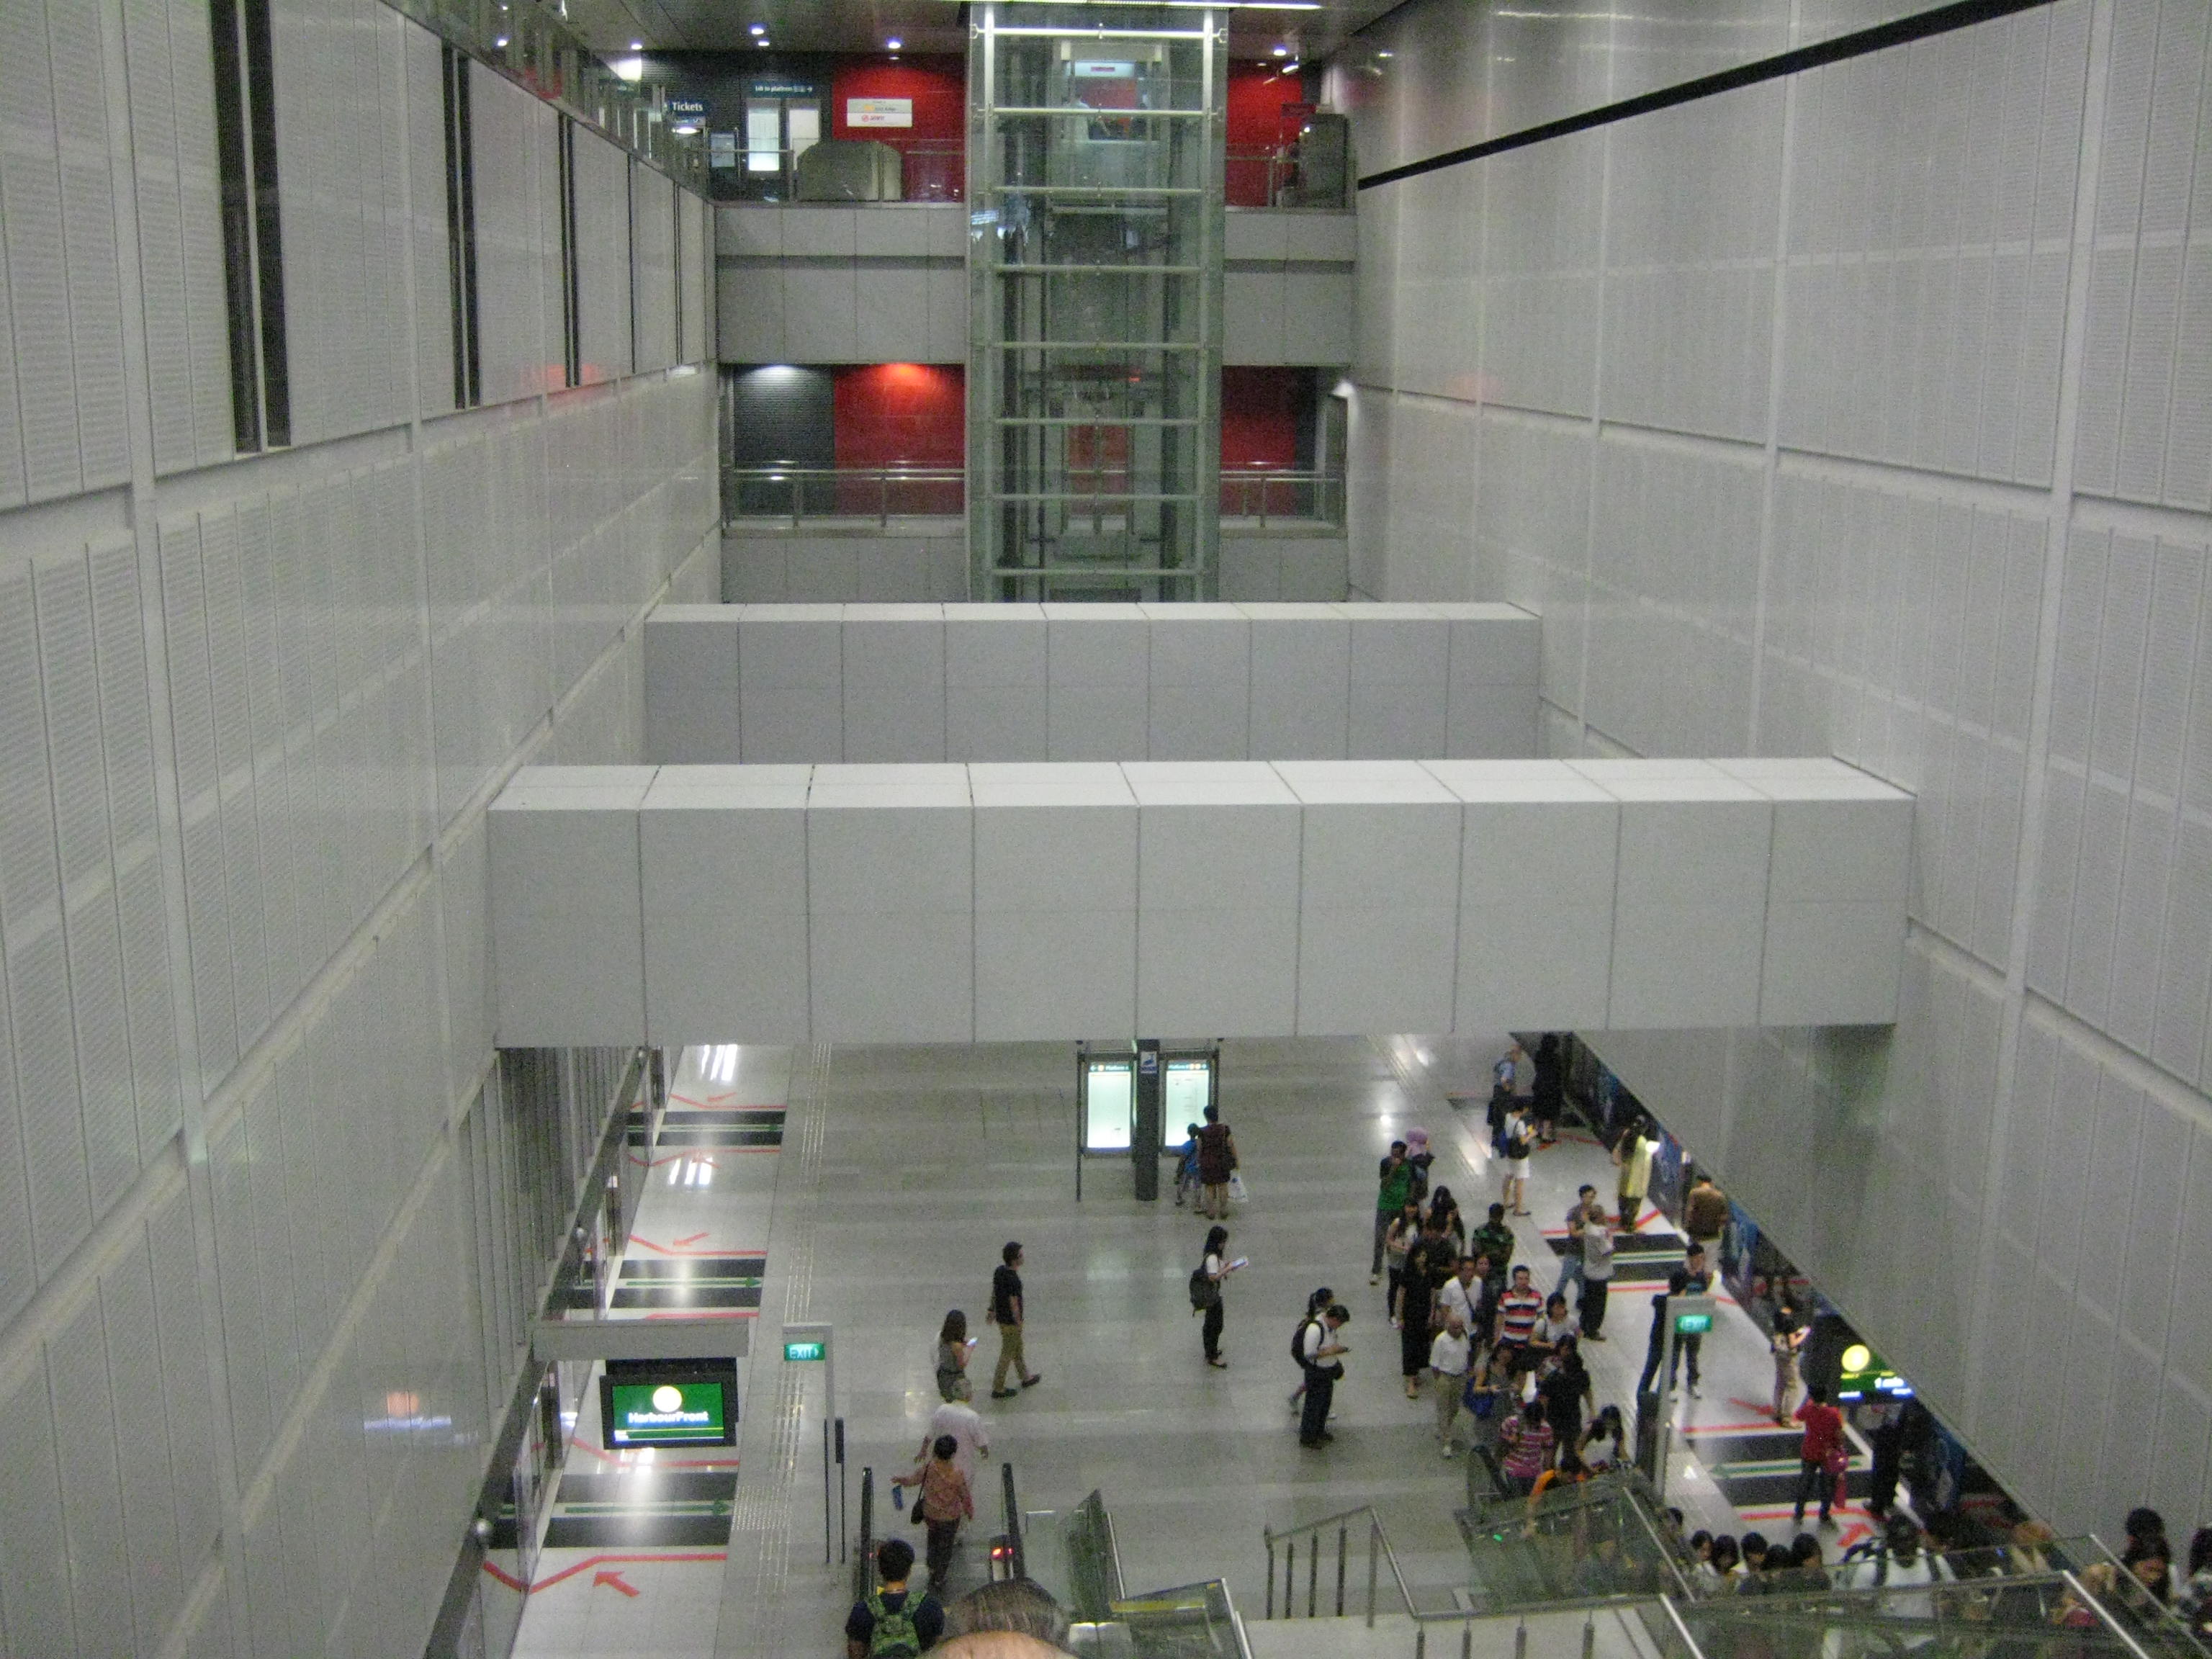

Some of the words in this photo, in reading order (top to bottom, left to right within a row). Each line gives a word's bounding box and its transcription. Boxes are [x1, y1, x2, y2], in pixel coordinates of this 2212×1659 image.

[672, 102, 703, 112] Tickets
[789, 1346, 812, 1359] EXIT
[628, 1411, 709, 1424] HarbourFront
